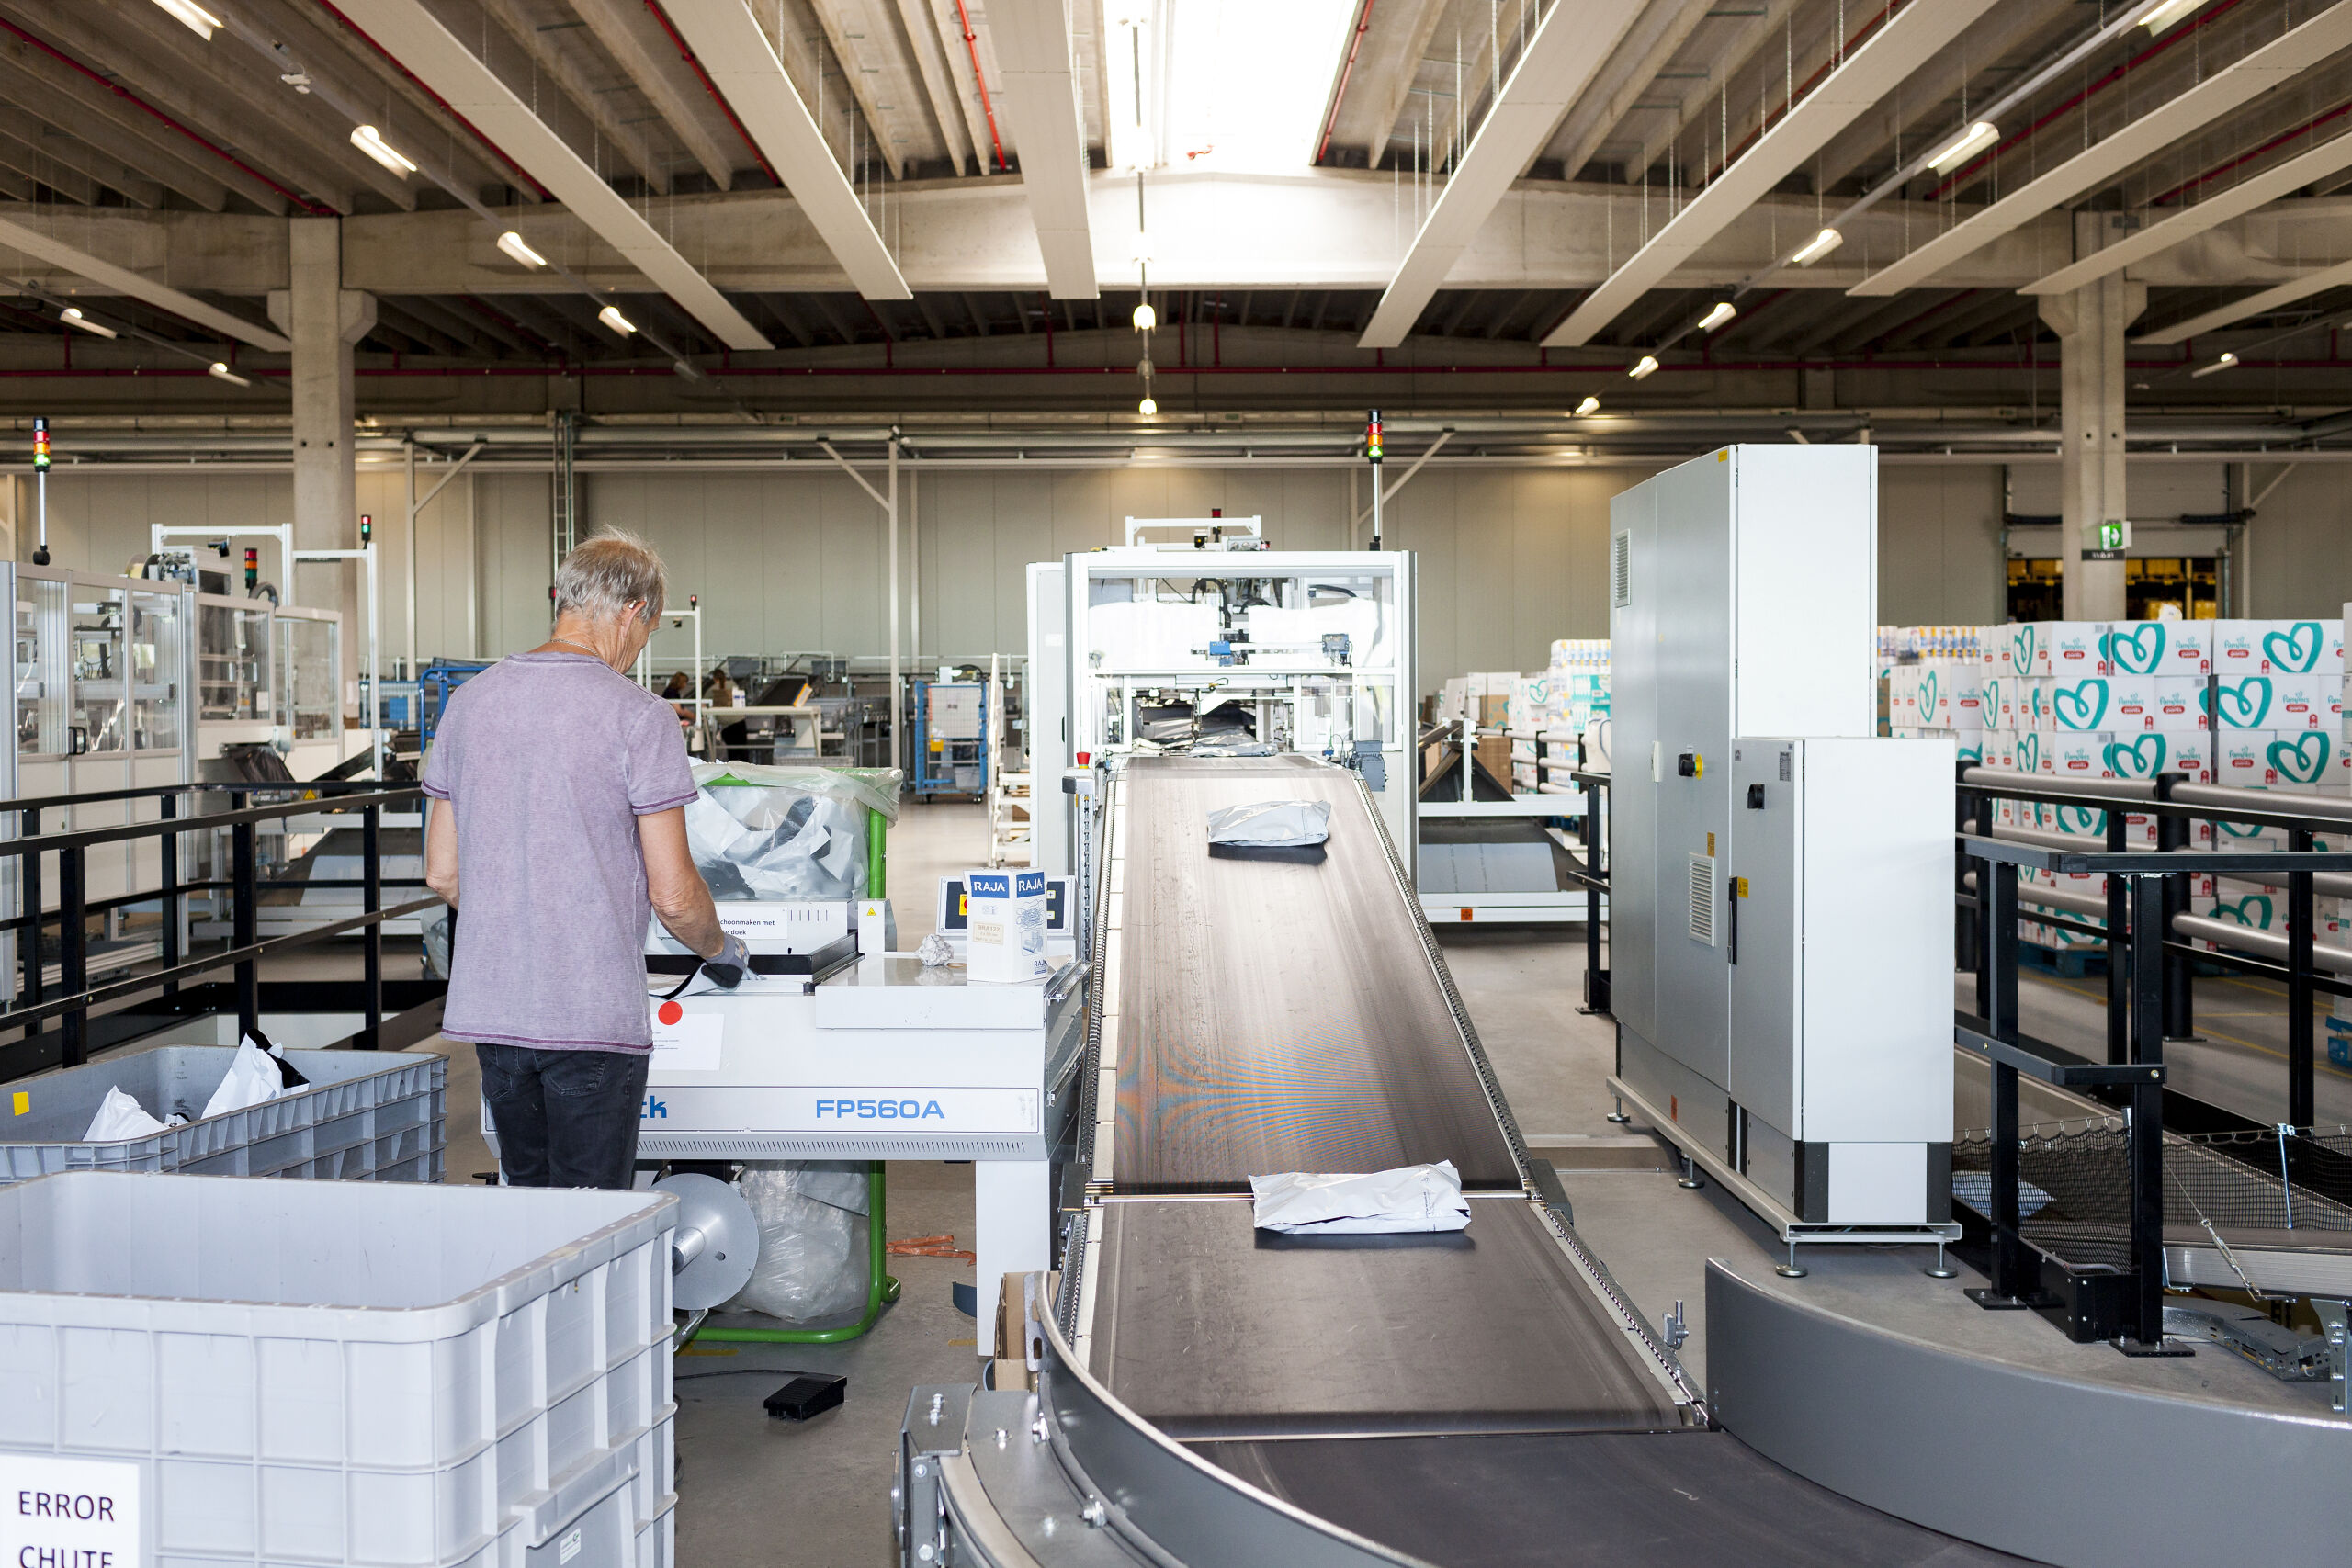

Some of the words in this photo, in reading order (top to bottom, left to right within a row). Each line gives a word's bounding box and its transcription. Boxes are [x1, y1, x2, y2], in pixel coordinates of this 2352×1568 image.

[2061, 641, 2086, 651] Pampers
[2176, 640, 2201, 650] Pampers
[2224, 639, 2251, 649] Pampers
[2118, 696, 2144, 706] Pampers
[2159, 696, 2187, 706] Pampers
[2282, 694, 2310, 705] Pampers
[2064, 751, 2090, 761] Pampers
[2176, 751, 2201, 761] Pampers
[2229, 749, 2255, 760] Pampers
[974, 881, 1006, 892] RAJA
[1018, 878, 1043, 892] RAJA
[816, 1100, 945, 1119] FP560A
[18, 1491, 115, 1522] ERROR
[19, 1545, 114, 1568] CHUTE
